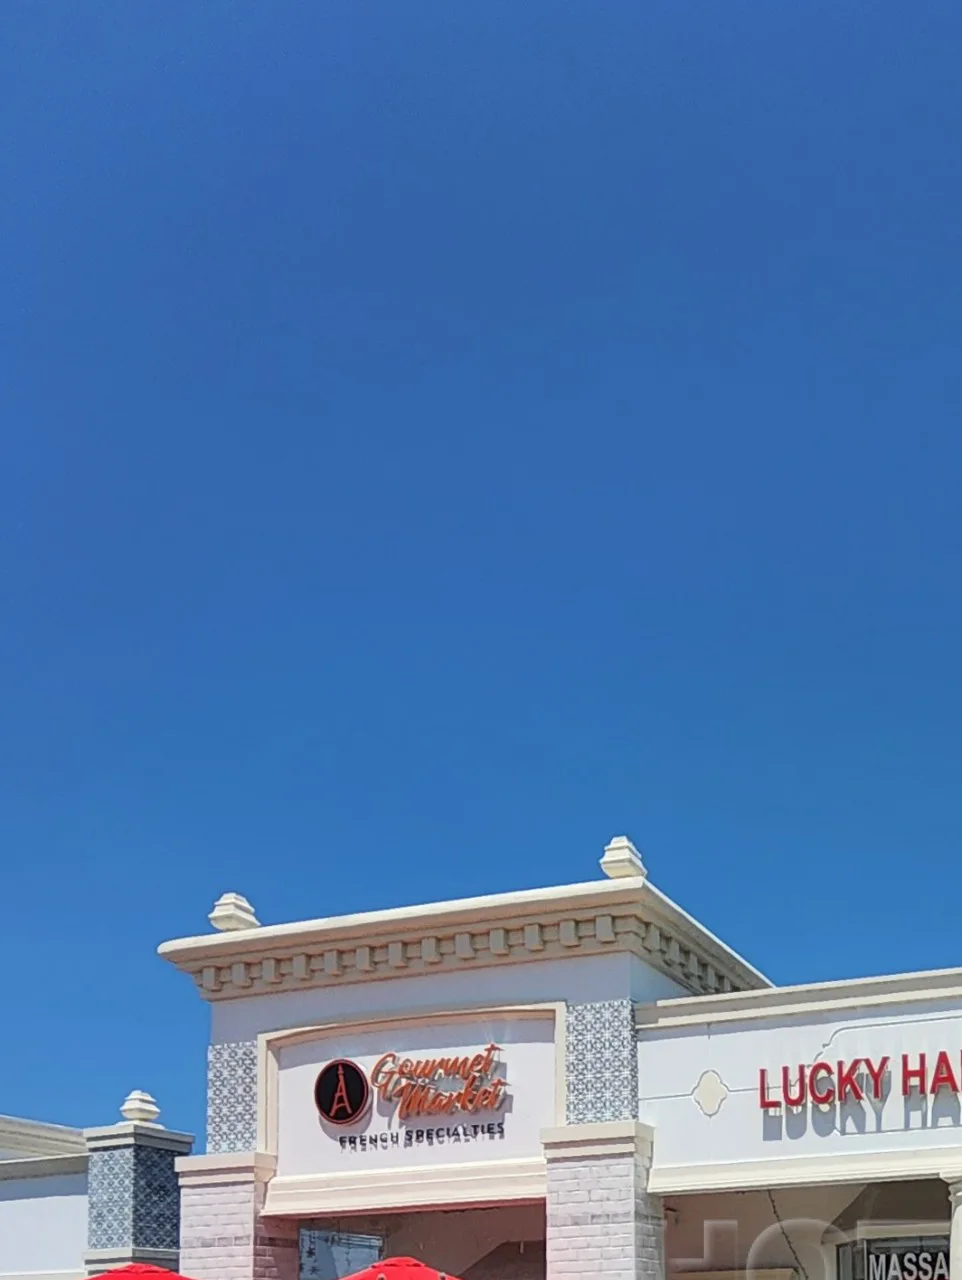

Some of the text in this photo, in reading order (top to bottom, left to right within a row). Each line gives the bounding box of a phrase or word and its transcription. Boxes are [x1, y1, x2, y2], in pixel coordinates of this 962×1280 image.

[370, 1041, 505, 1101] Gourmet
[759, 1055, 891, 1109] LUCKY
[393, 1075, 511, 1121] Market
[338, 1122, 505, 1147] FRENCH SPECIALTIES
